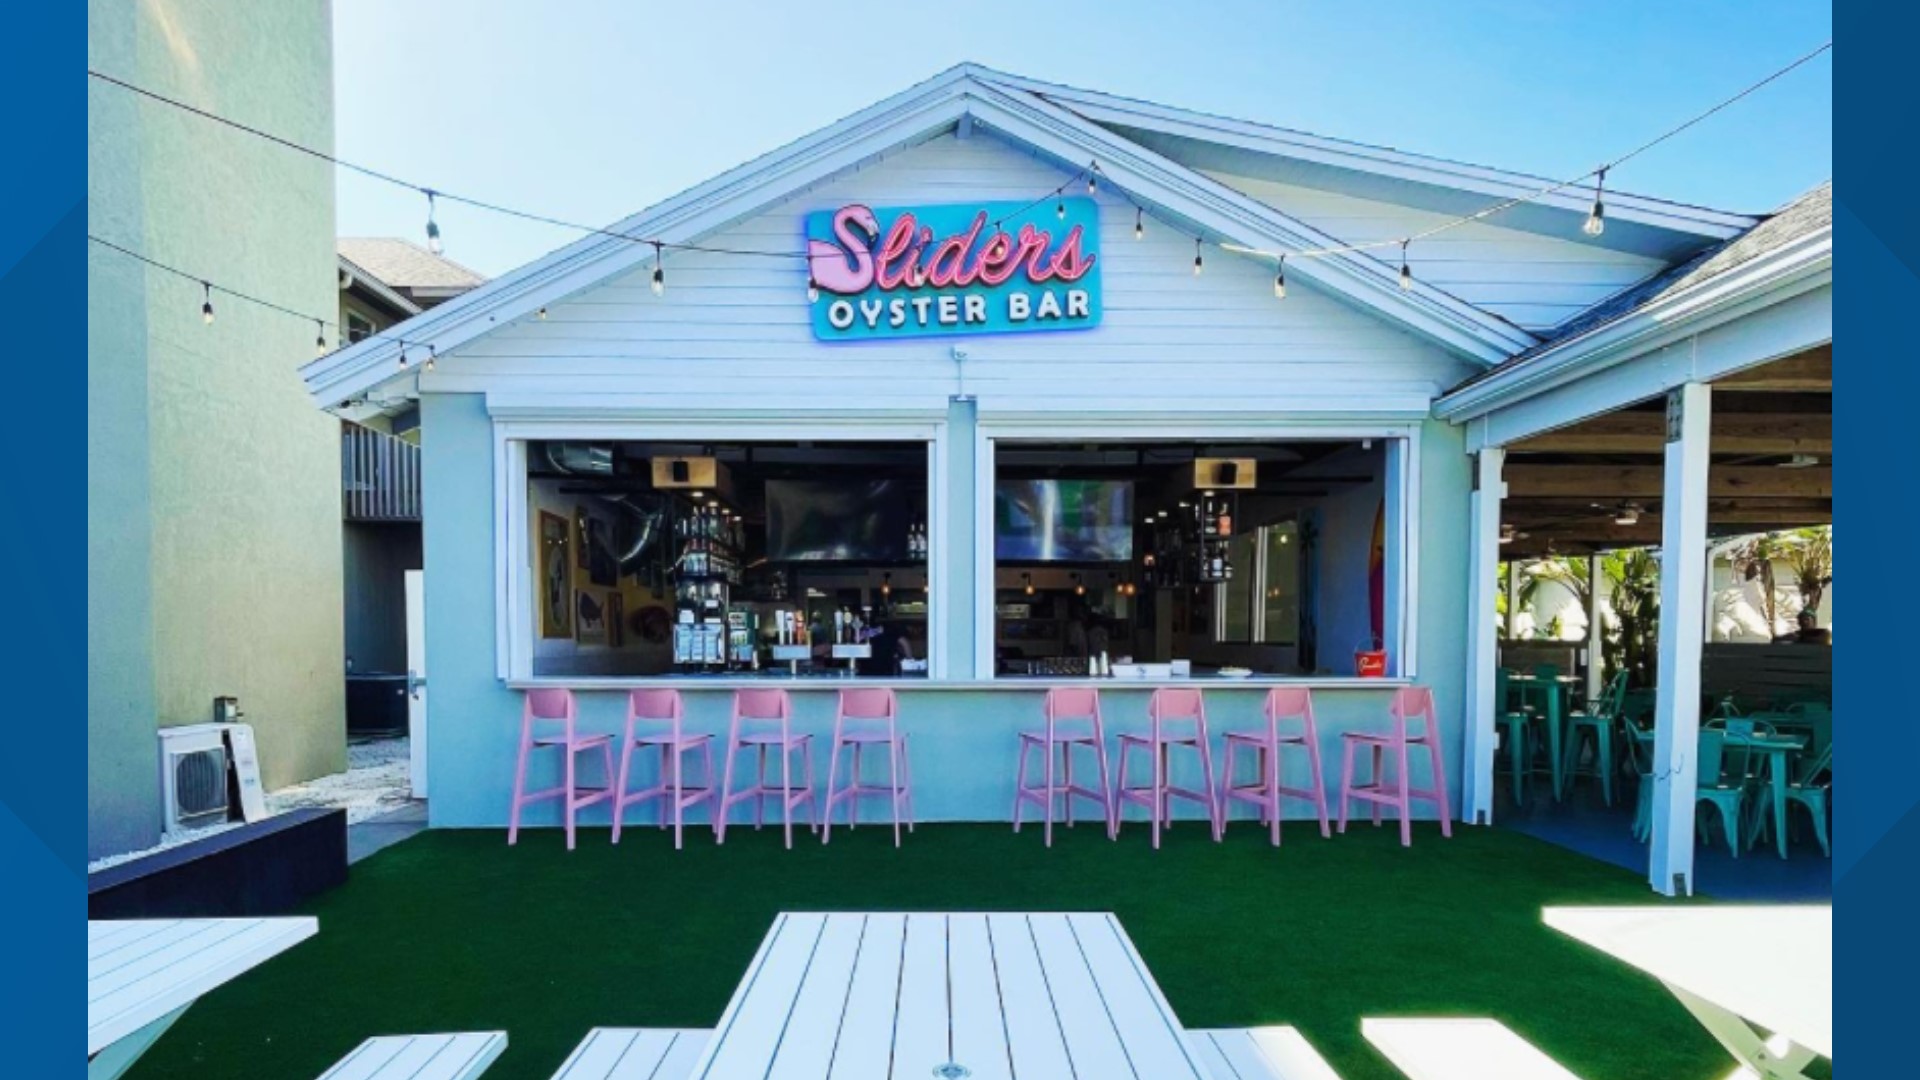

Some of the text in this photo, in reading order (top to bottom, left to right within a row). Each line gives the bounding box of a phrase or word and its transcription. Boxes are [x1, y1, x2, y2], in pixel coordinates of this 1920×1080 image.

[808, 204, 1096, 294] Sliders
[828, 290, 1090, 328] OYSTER BAR
